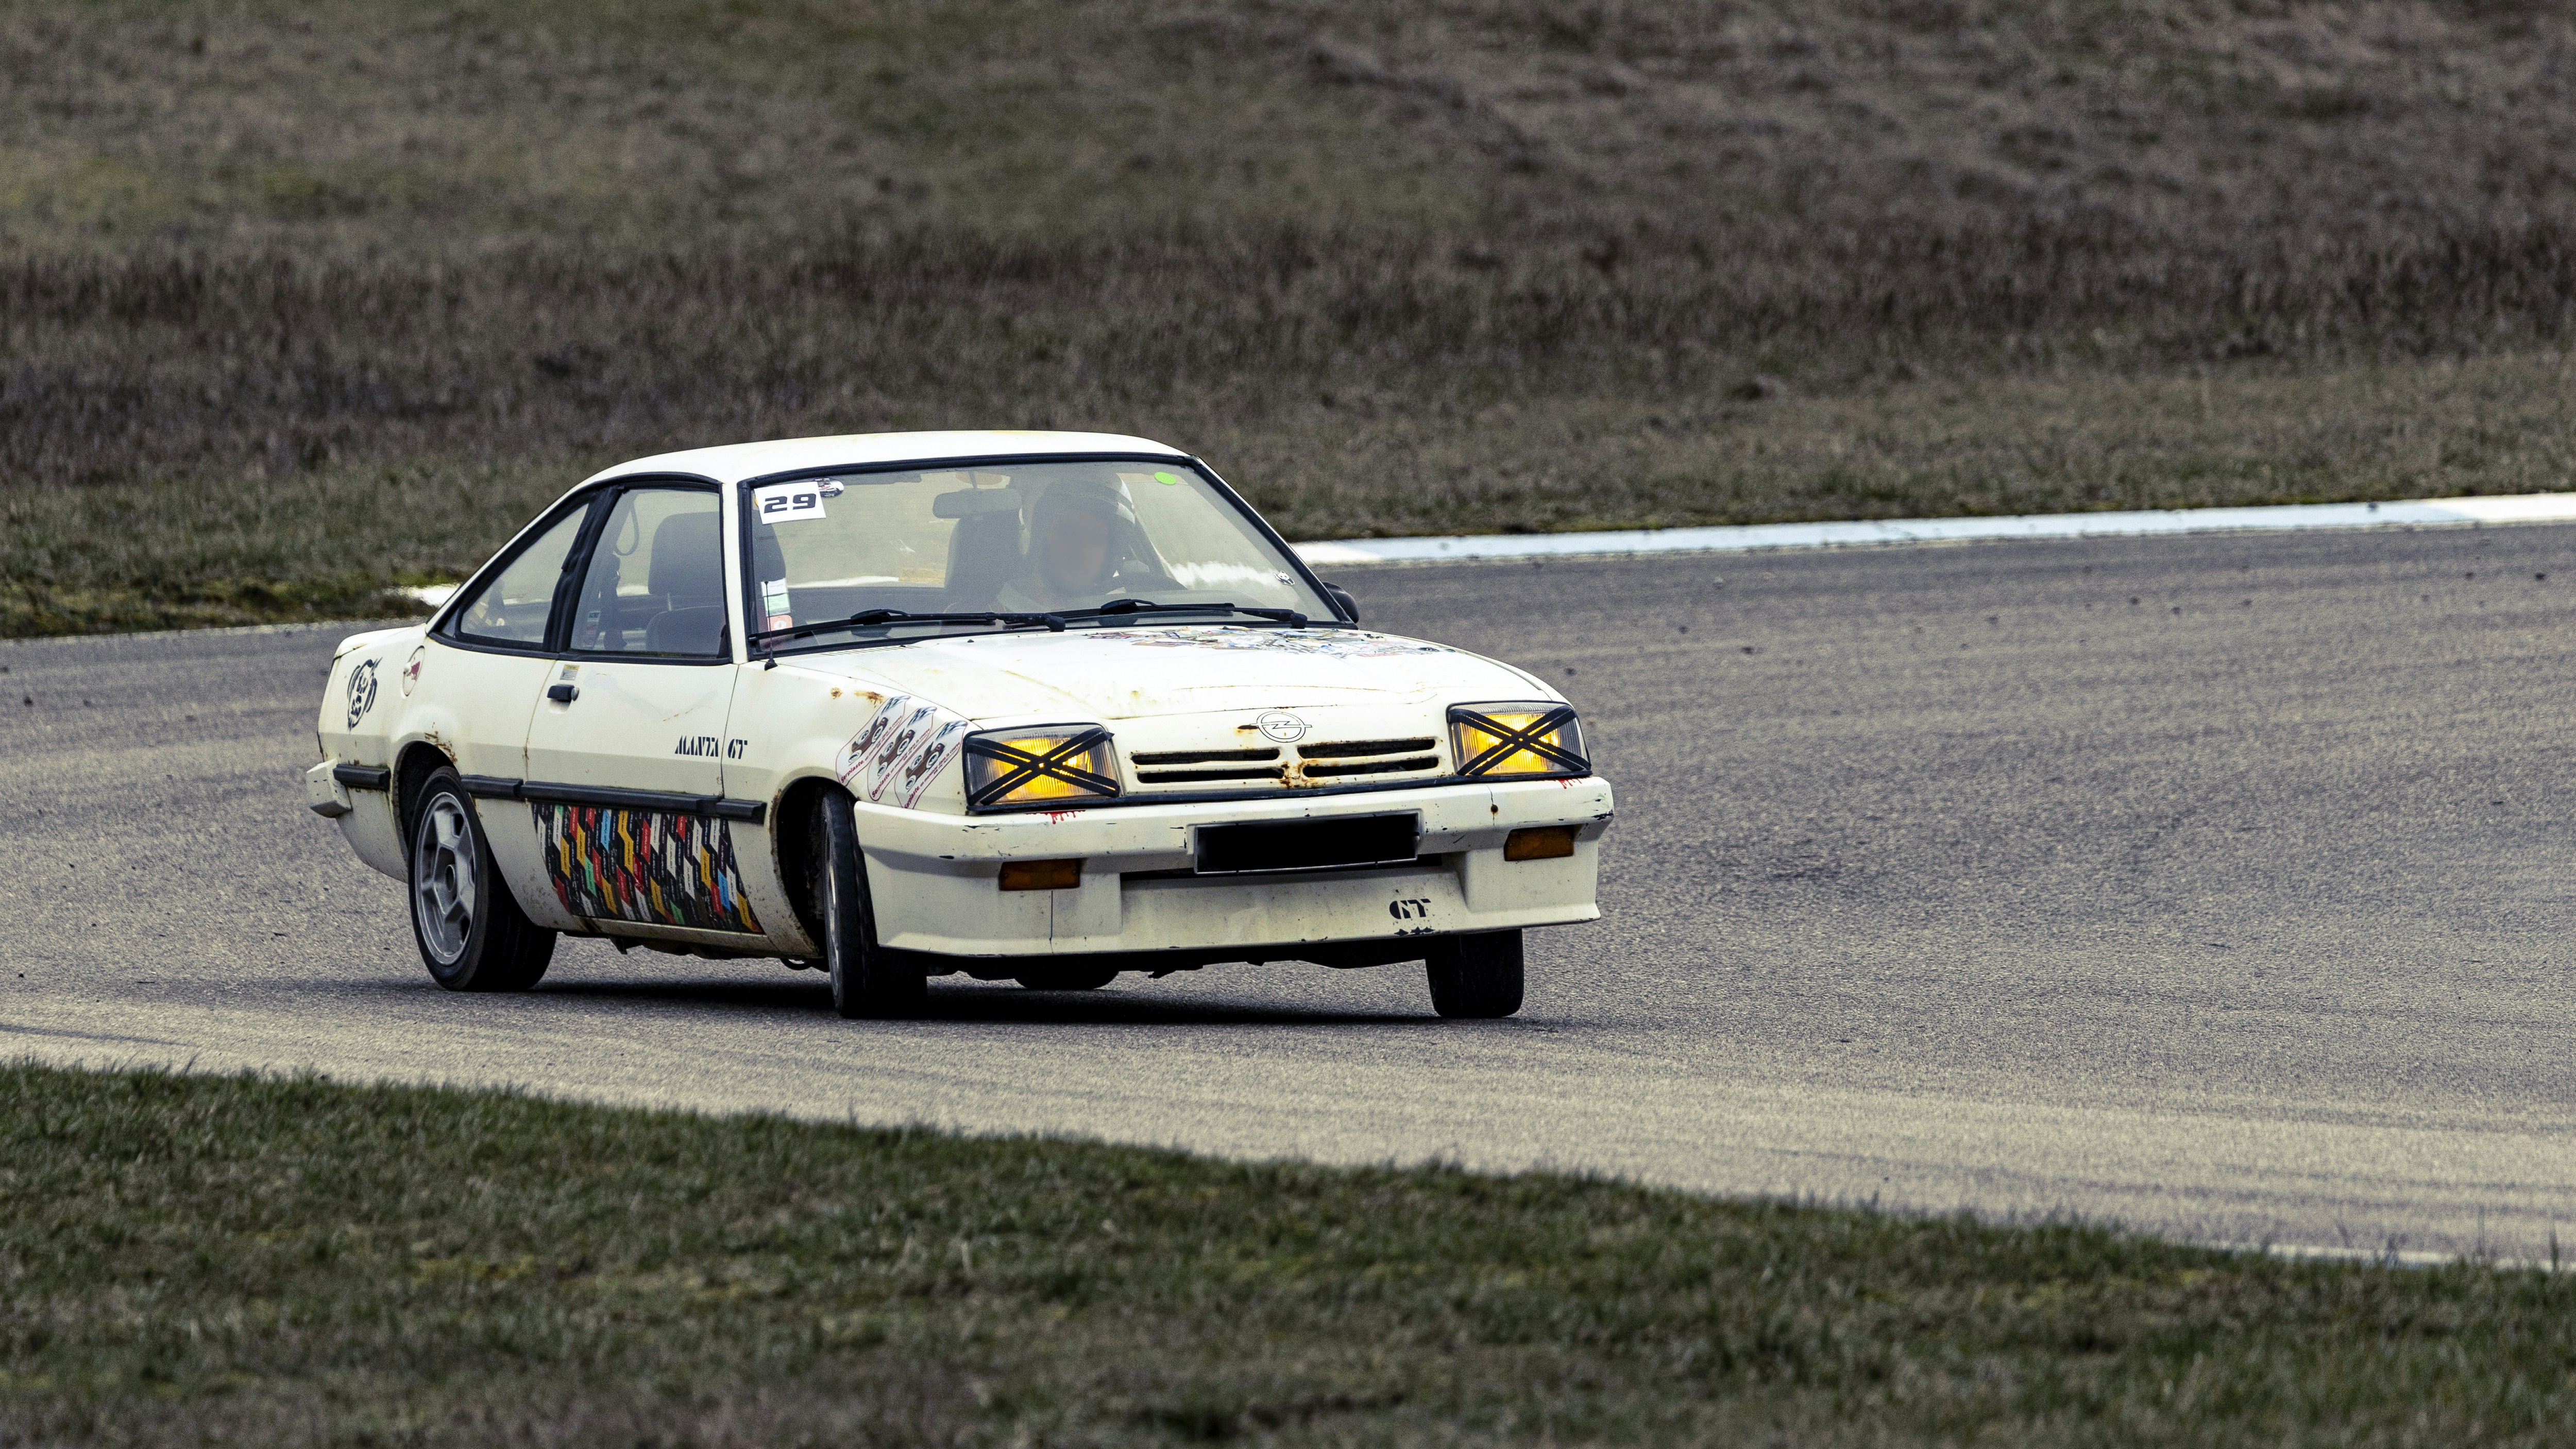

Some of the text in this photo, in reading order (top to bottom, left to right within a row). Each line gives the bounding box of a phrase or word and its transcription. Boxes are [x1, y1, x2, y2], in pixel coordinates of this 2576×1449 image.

[764, 493, 817, 514] 29
[674, 735, 748, 759] MANTA GT
[1389, 898, 1431, 919] GT
